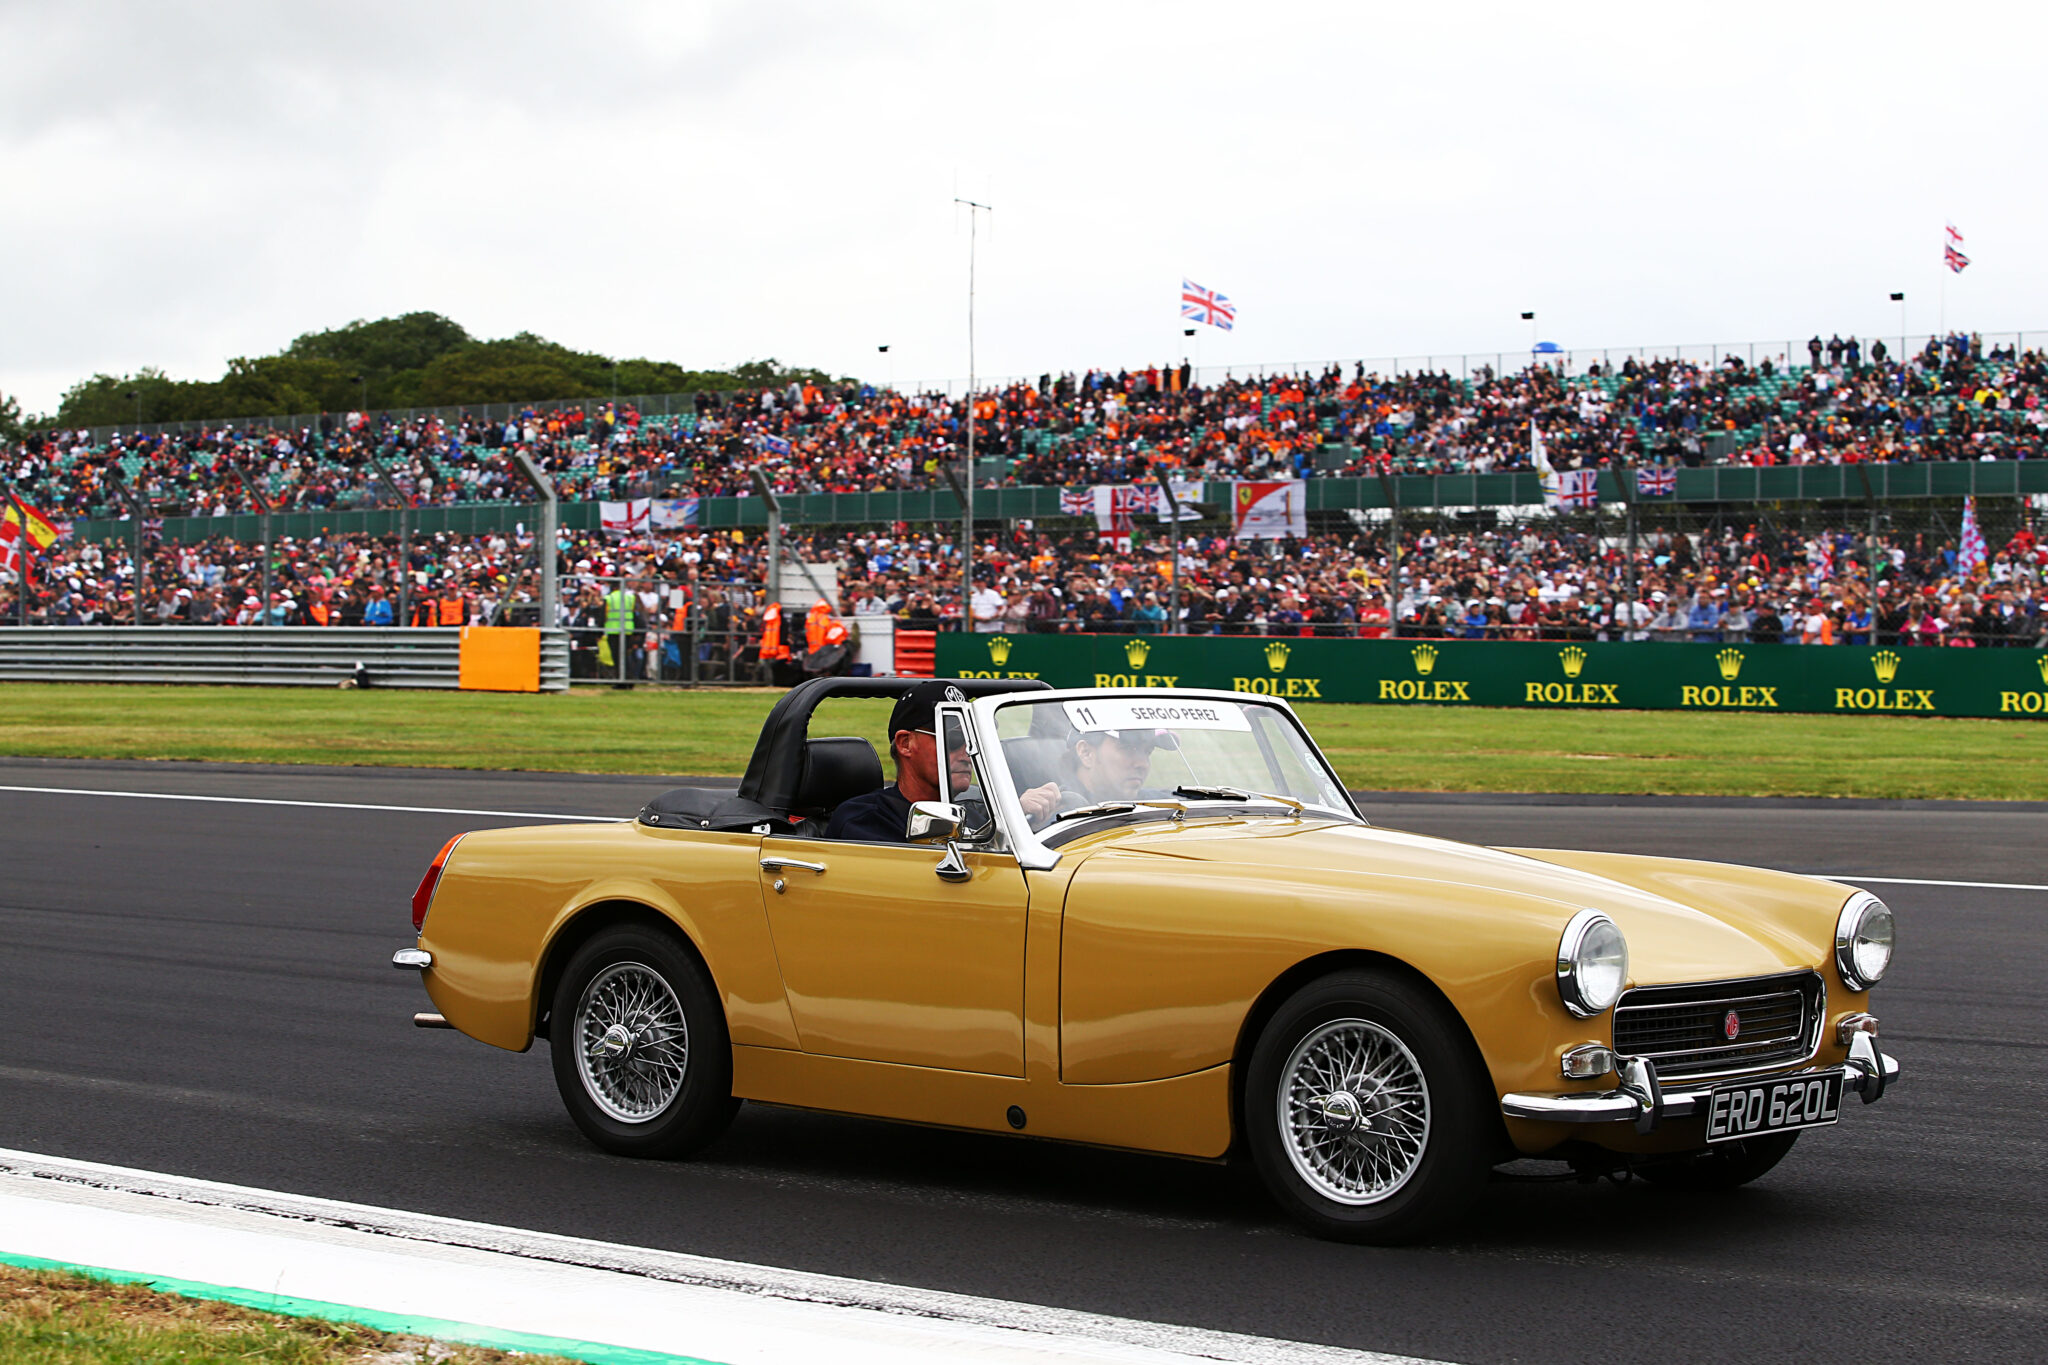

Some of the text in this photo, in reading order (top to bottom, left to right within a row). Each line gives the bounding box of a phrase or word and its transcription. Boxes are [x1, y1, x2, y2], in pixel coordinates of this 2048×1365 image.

[1233, 677, 1322, 698] ROLEX
[1379, 679, 1471, 701] ROLEX
[1525, 682, 1620, 704] ROLEX
[1681, 685, 1778, 707] ROLEX
[1835, 688, 1935, 710] ROLEX
[1076, 707, 1220, 725] 11 SERGIO PEREZ
[1710, 1080, 1837, 1136] ERD 620L
